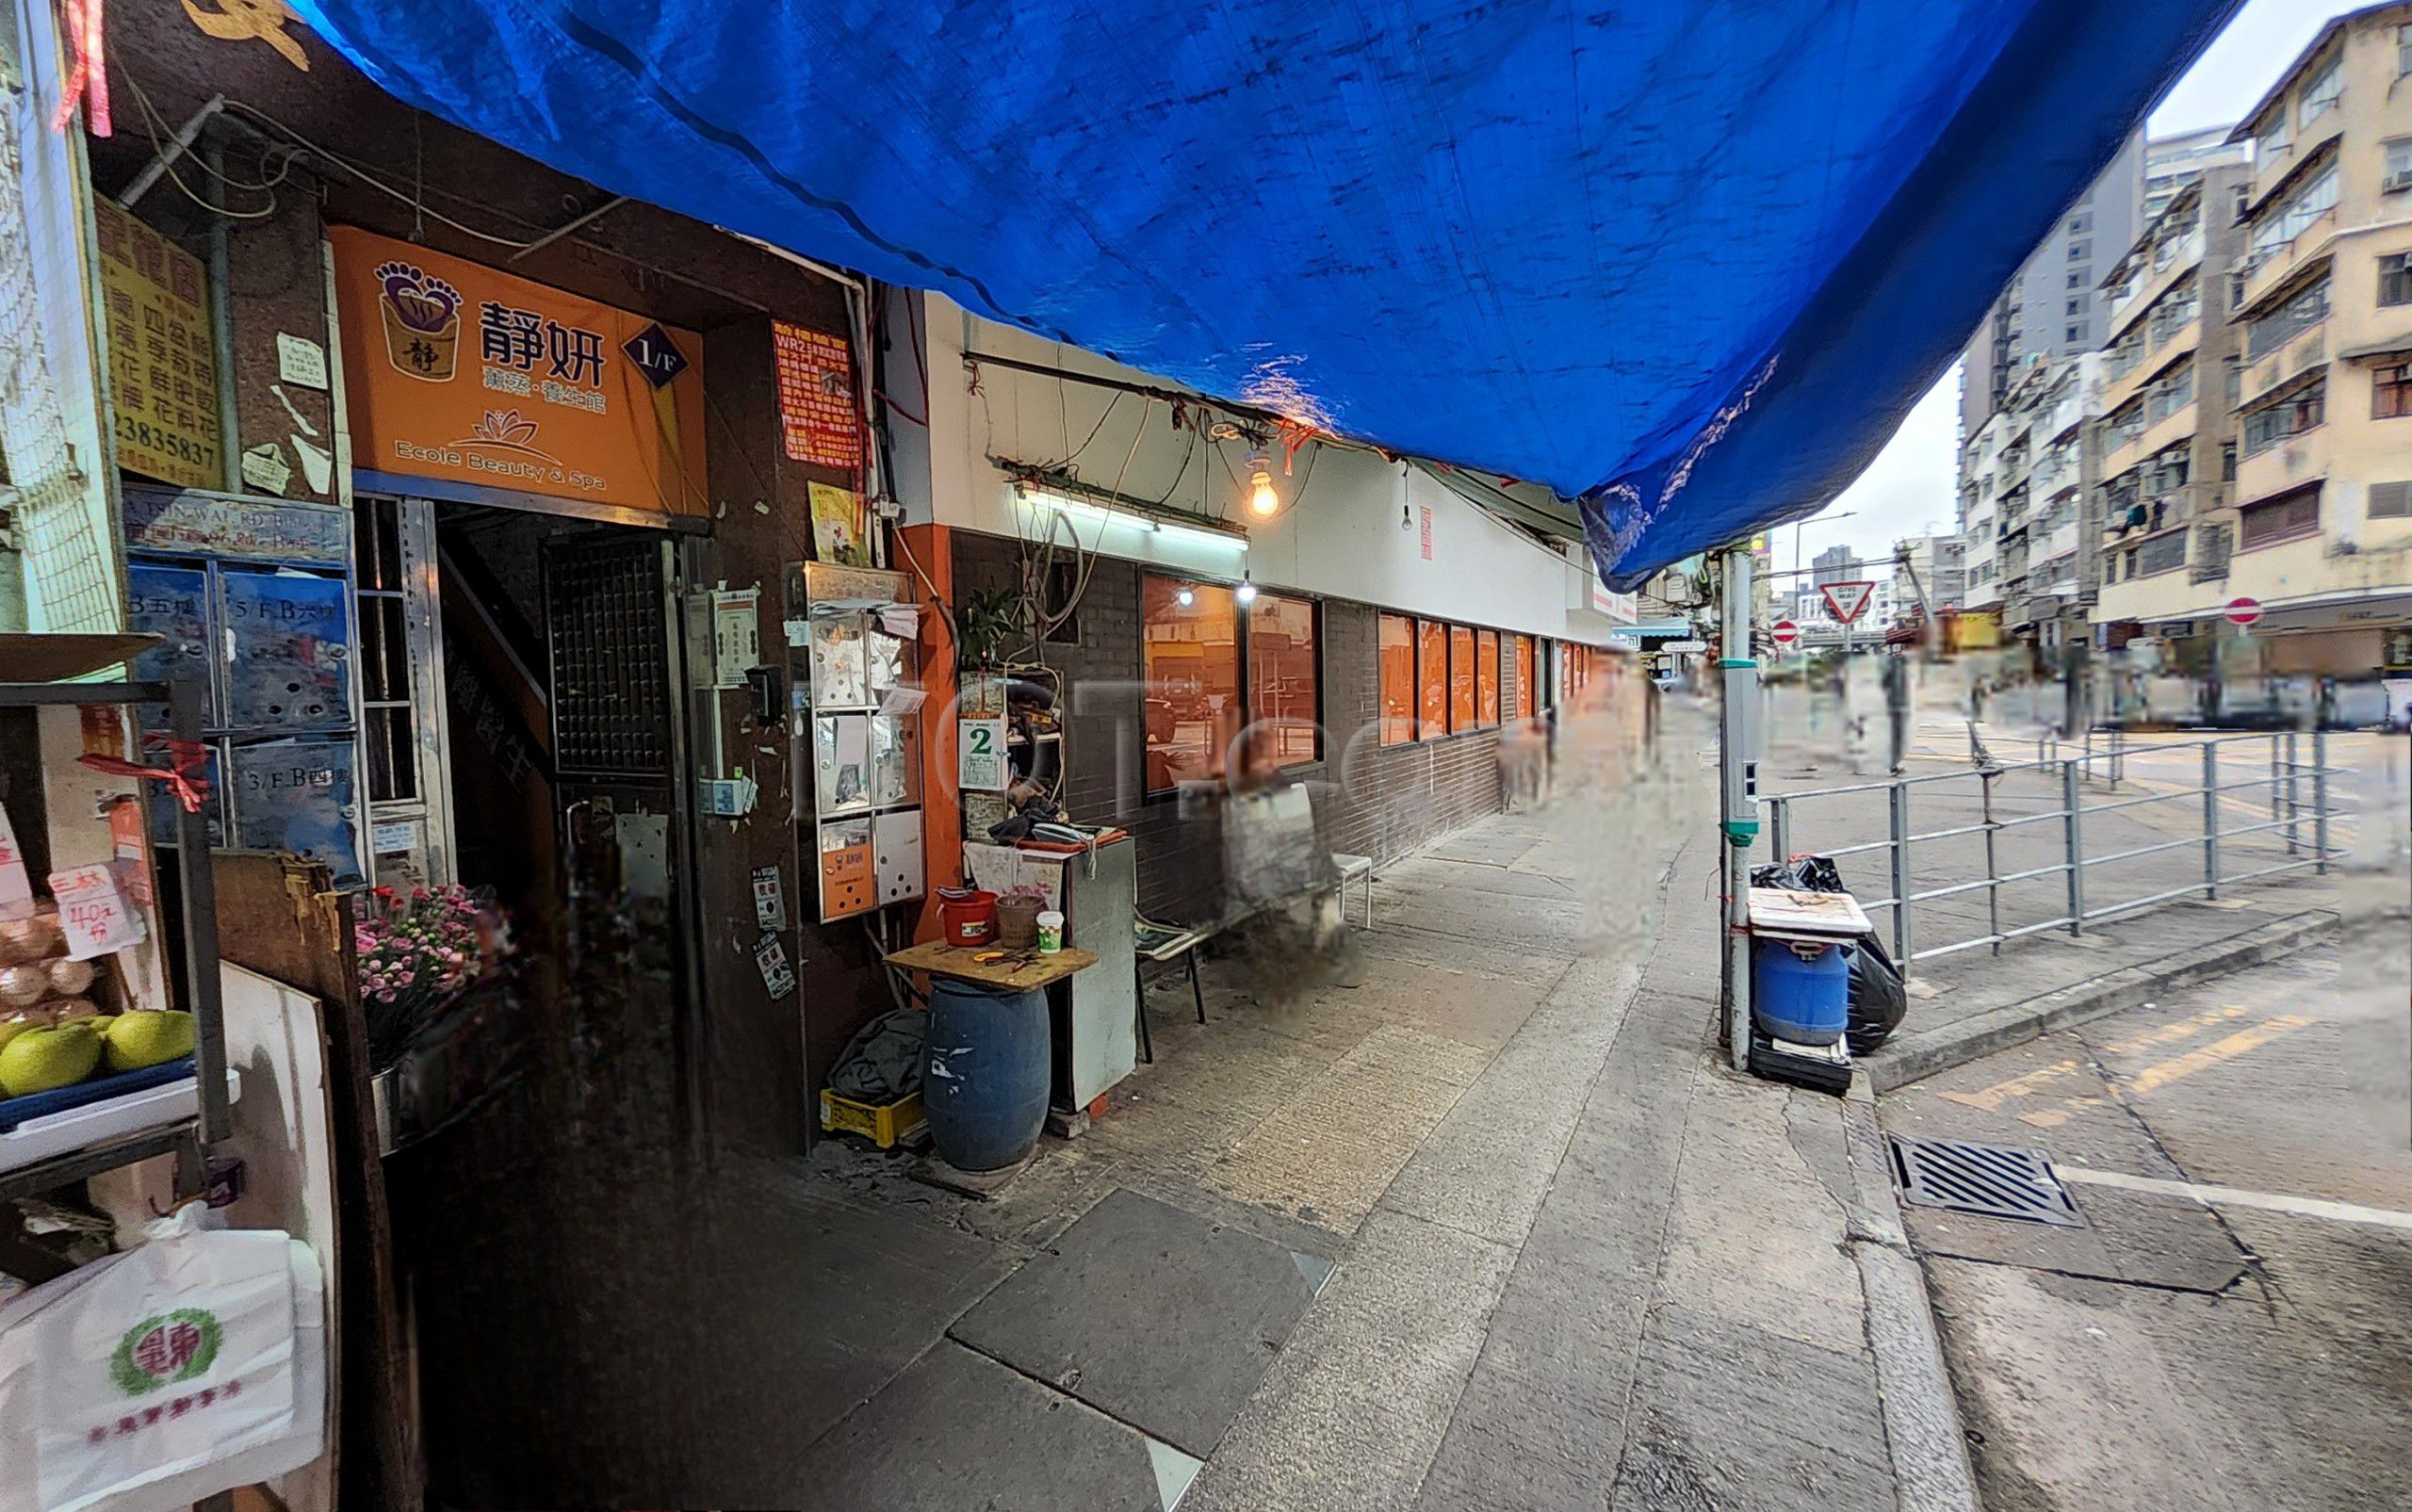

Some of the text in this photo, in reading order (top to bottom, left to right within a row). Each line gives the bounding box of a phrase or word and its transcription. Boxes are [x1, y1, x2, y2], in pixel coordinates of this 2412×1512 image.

[480, 302, 605, 387] 靜妍
[638, 339, 676, 372] 1/F
[395, 440, 606, 490] Ecole Beauty & Spa
[970, 728, 992, 755] 2
